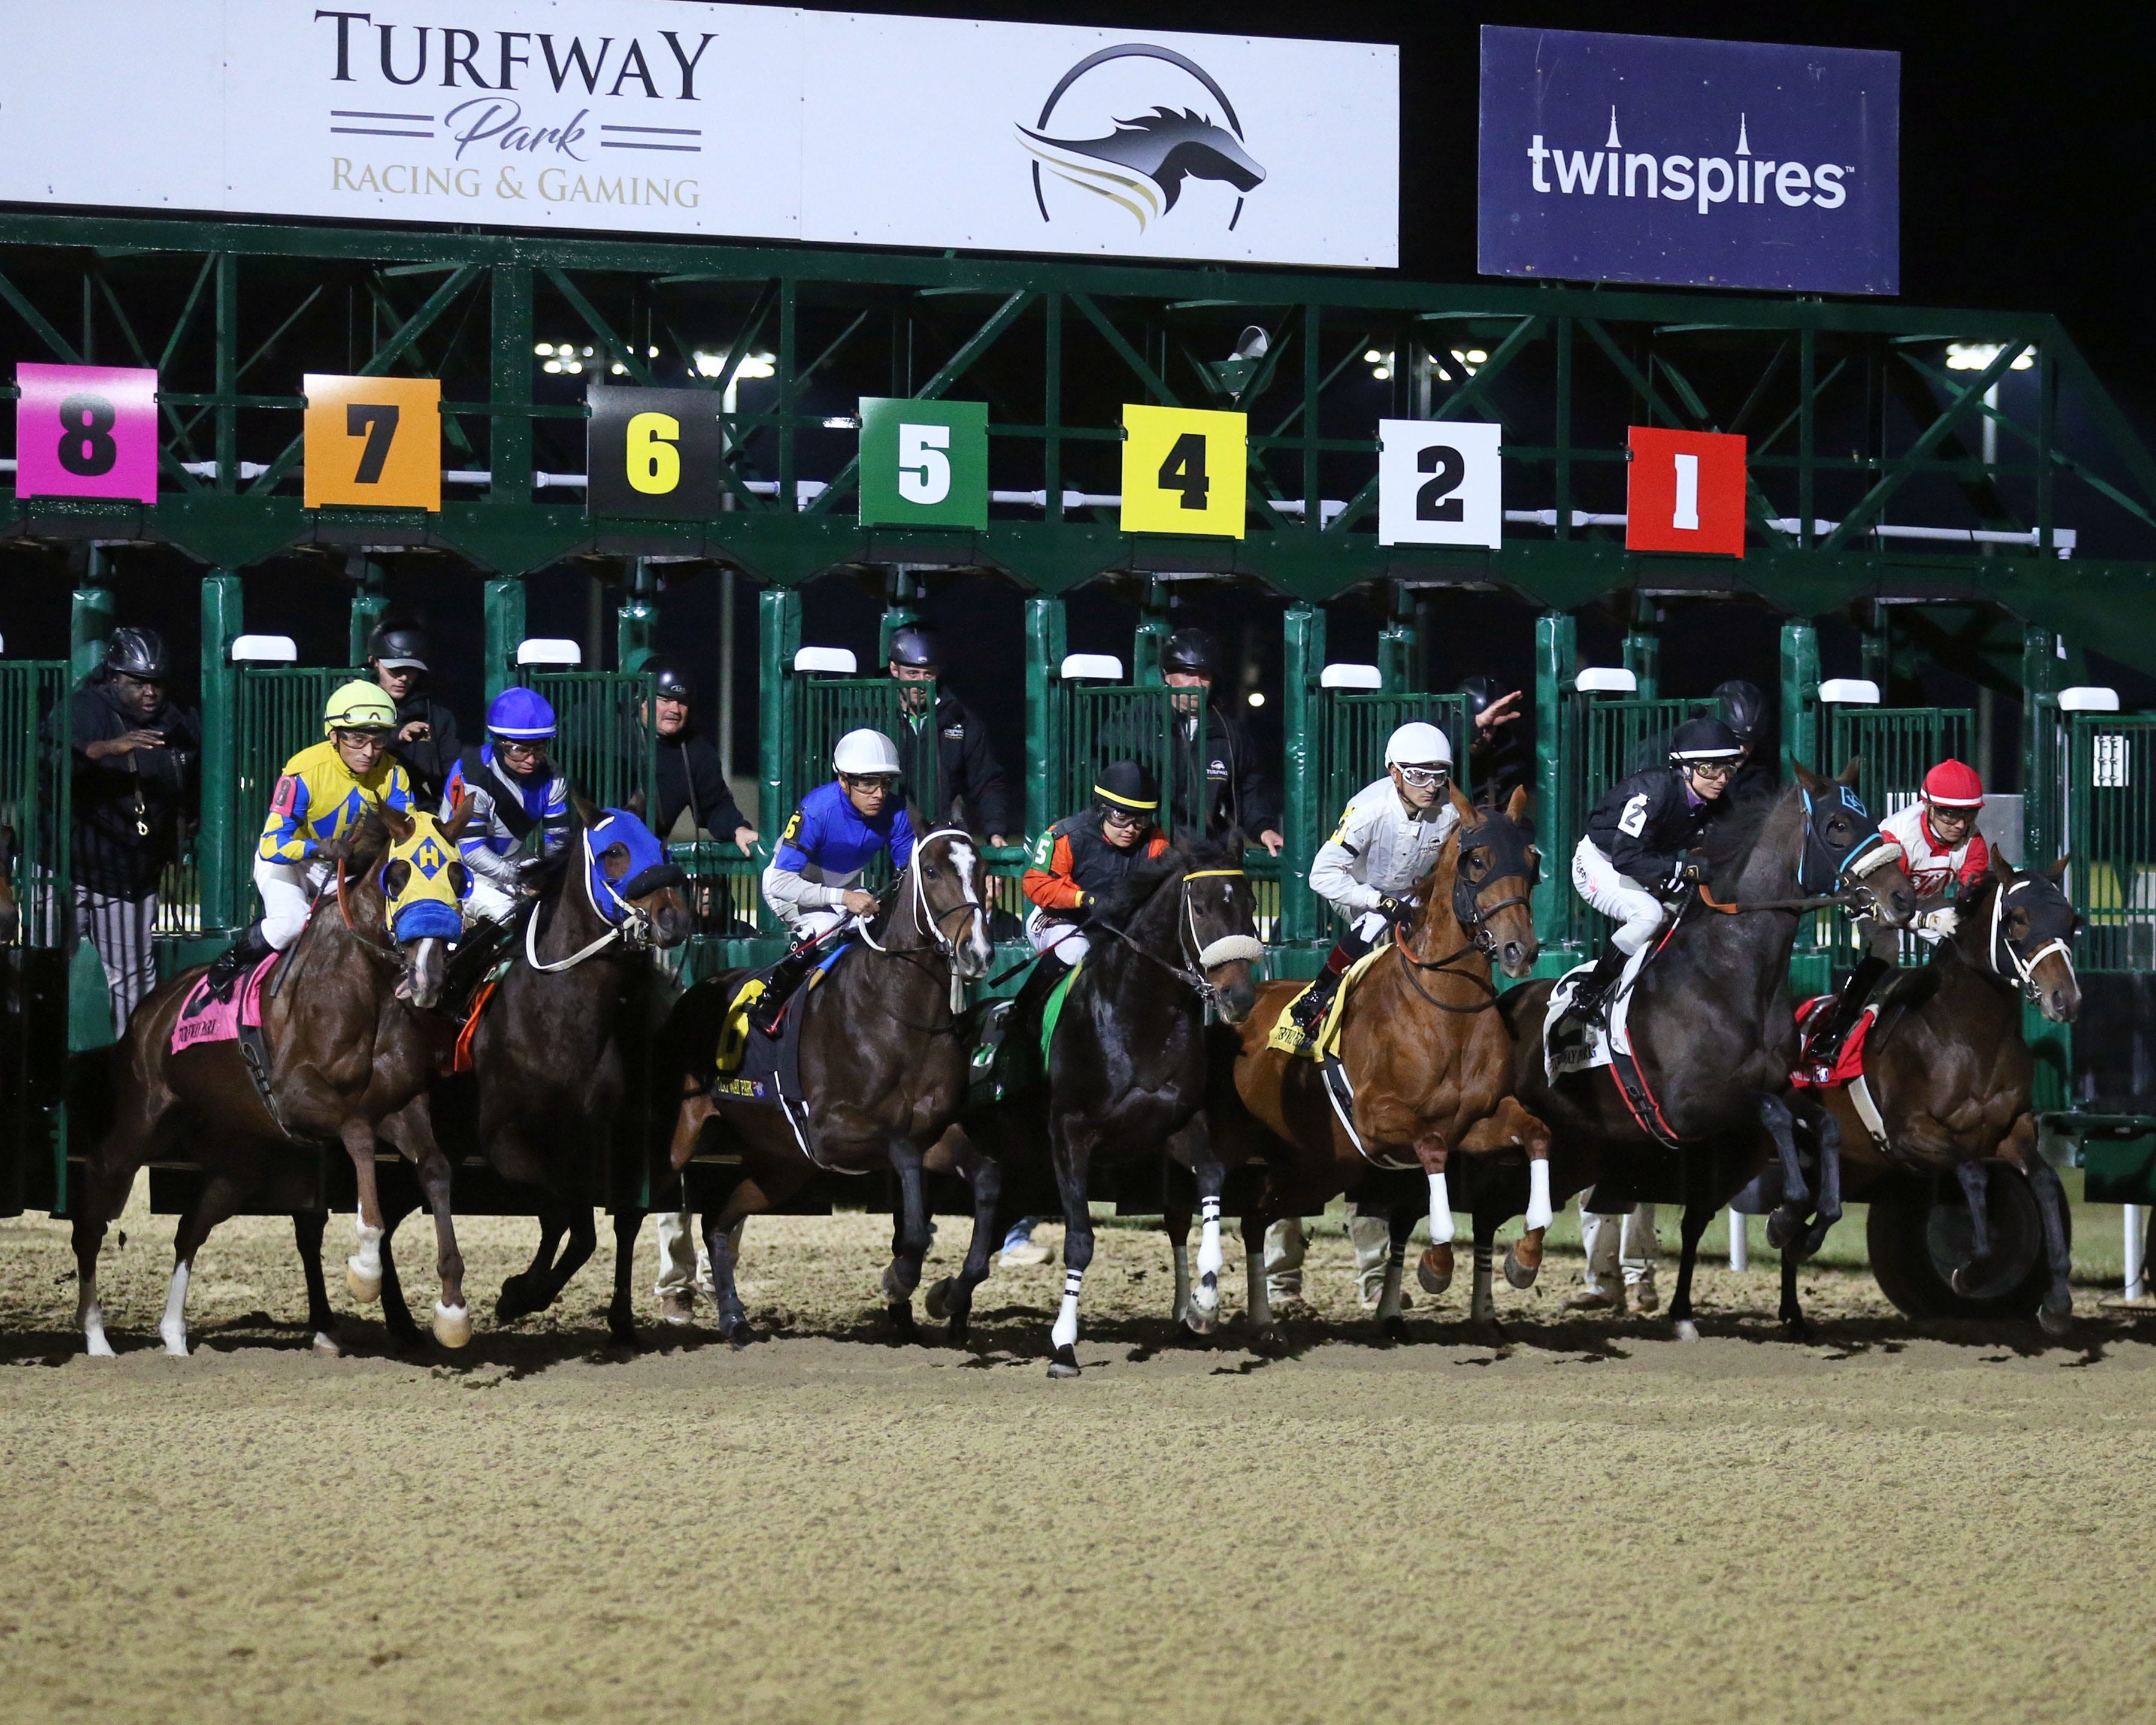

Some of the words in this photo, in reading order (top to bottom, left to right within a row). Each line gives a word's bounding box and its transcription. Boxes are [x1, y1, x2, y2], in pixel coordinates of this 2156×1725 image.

[314, 9, 719, 101] TURFWAY
[444, 96, 591, 162] Park
[1527, 105, 1845, 214] twinspires
[330, 157, 482, 197] RACING
[496, 165, 528, 200] &
[538, 168, 700, 208] GAMING
[57, 392, 117, 477] 8
[346, 403, 400, 485] 7
[626, 411, 682, 495] 6
[898, 423, 951, 504] 5
[1158, 432, 1210, 511] 4
[1416, 445, 1465, 522] 2
[1672, 453, 1699, 530] 1
[276, 779, 291, 806] 8
[453, 785, 461, 810] 7
[784, 814, 801, 839] 6
[1624, 803, 1643, 828] 2
[419, 845, 440, 868] H
[1034, 838, 1051, 865] 5
